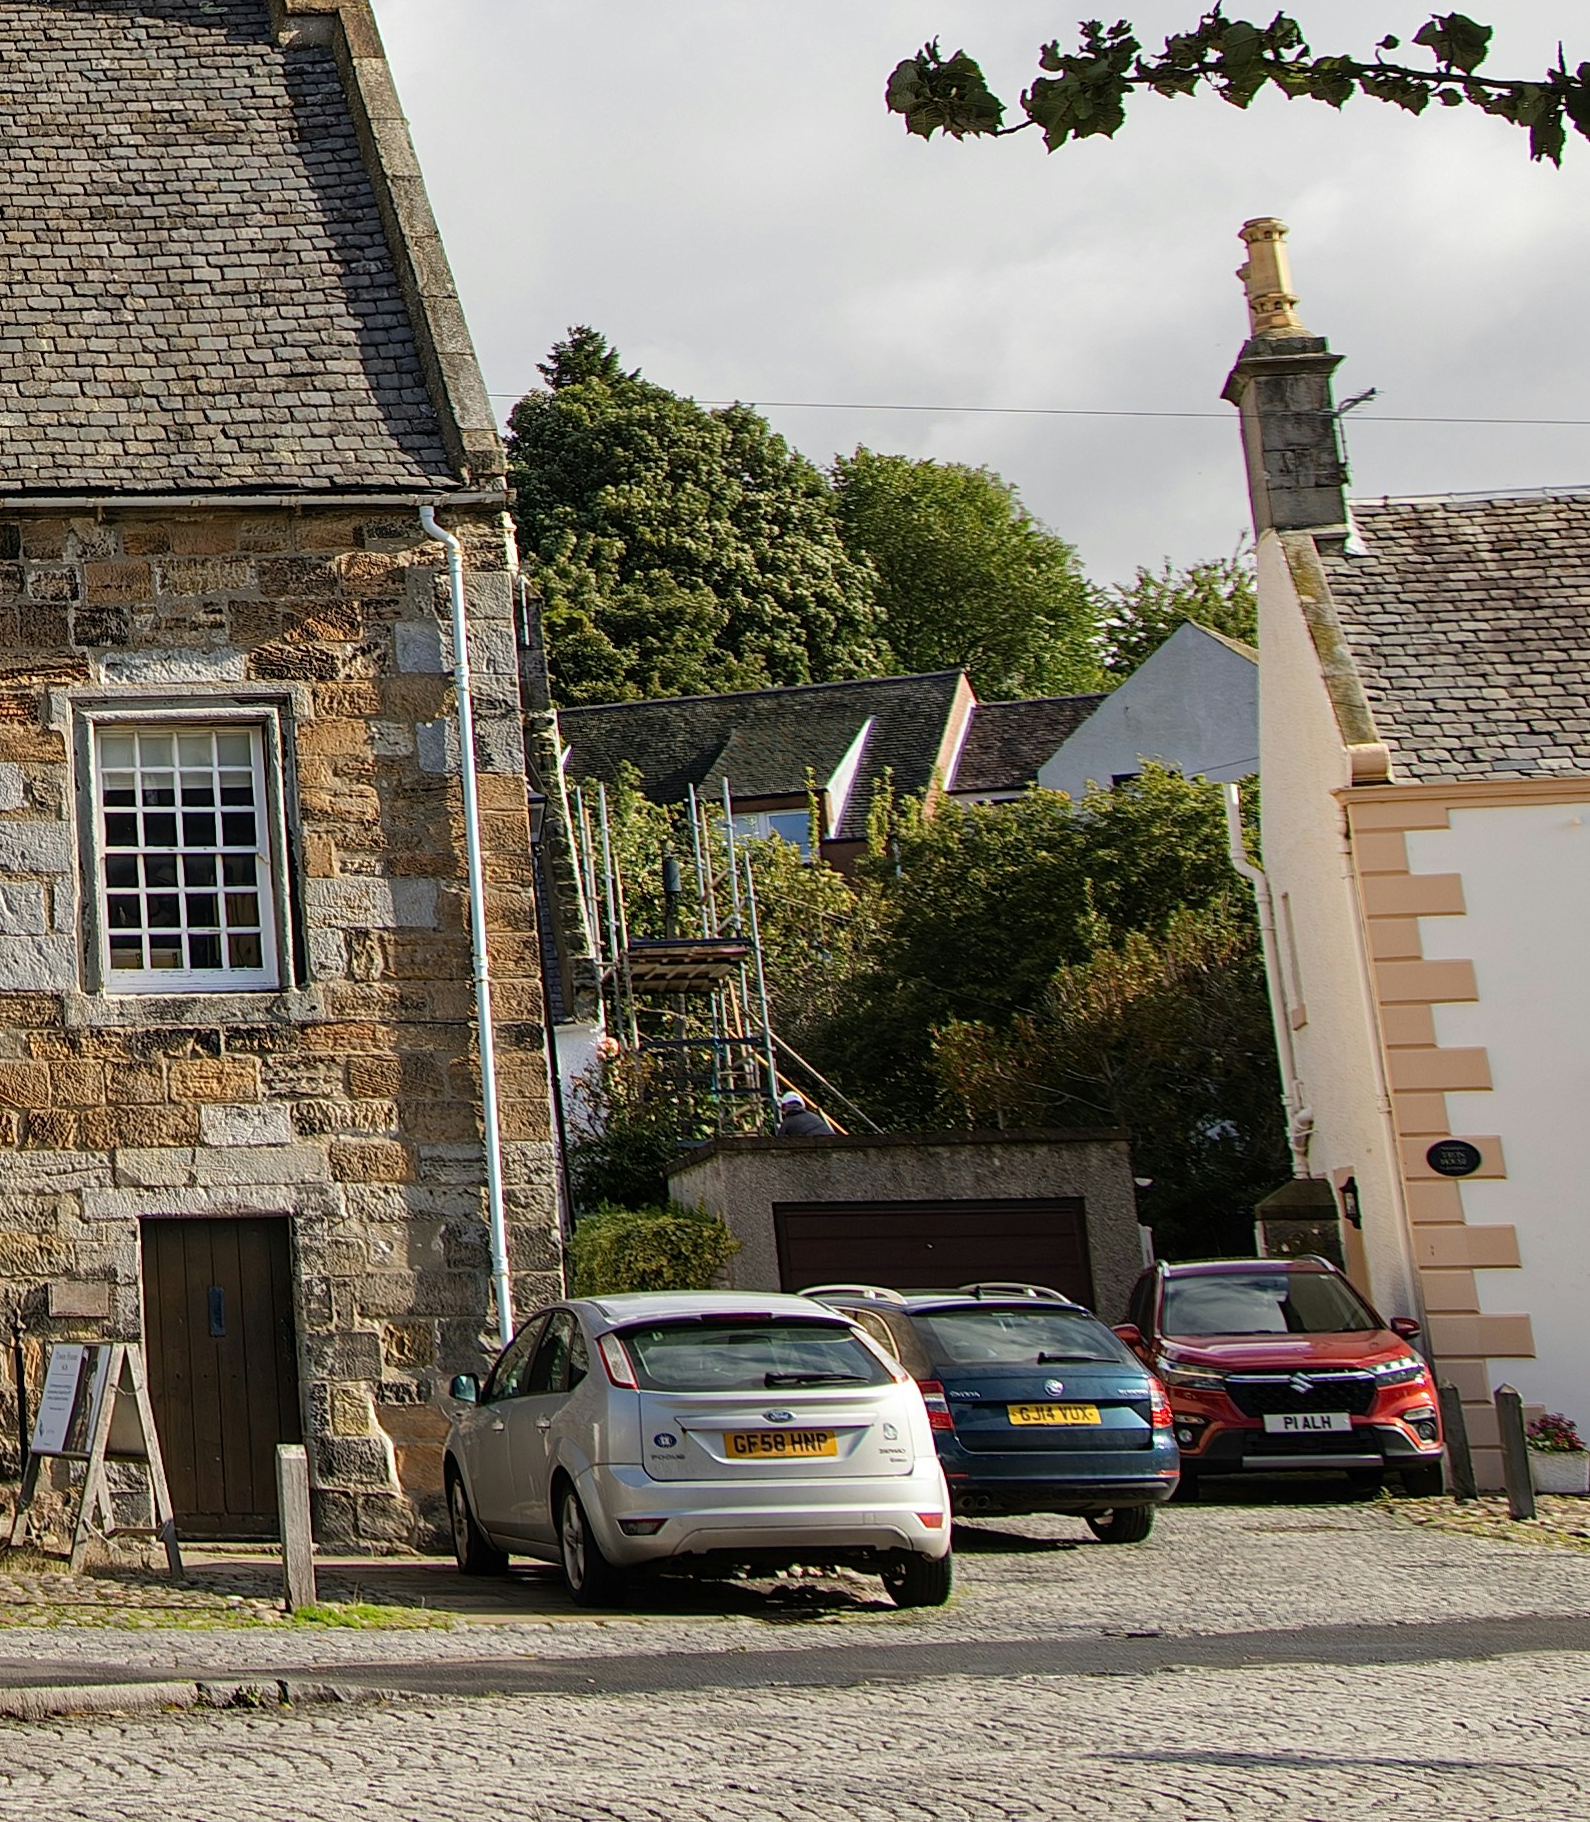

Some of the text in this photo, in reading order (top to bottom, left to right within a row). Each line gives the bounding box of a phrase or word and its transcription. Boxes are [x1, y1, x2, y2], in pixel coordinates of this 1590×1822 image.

[1059, 1406, 1091, 1421] VUX
[1302, 1415, 1332, 1429] ALH
[734, 1432, 828, 1453] GF58 HNP
